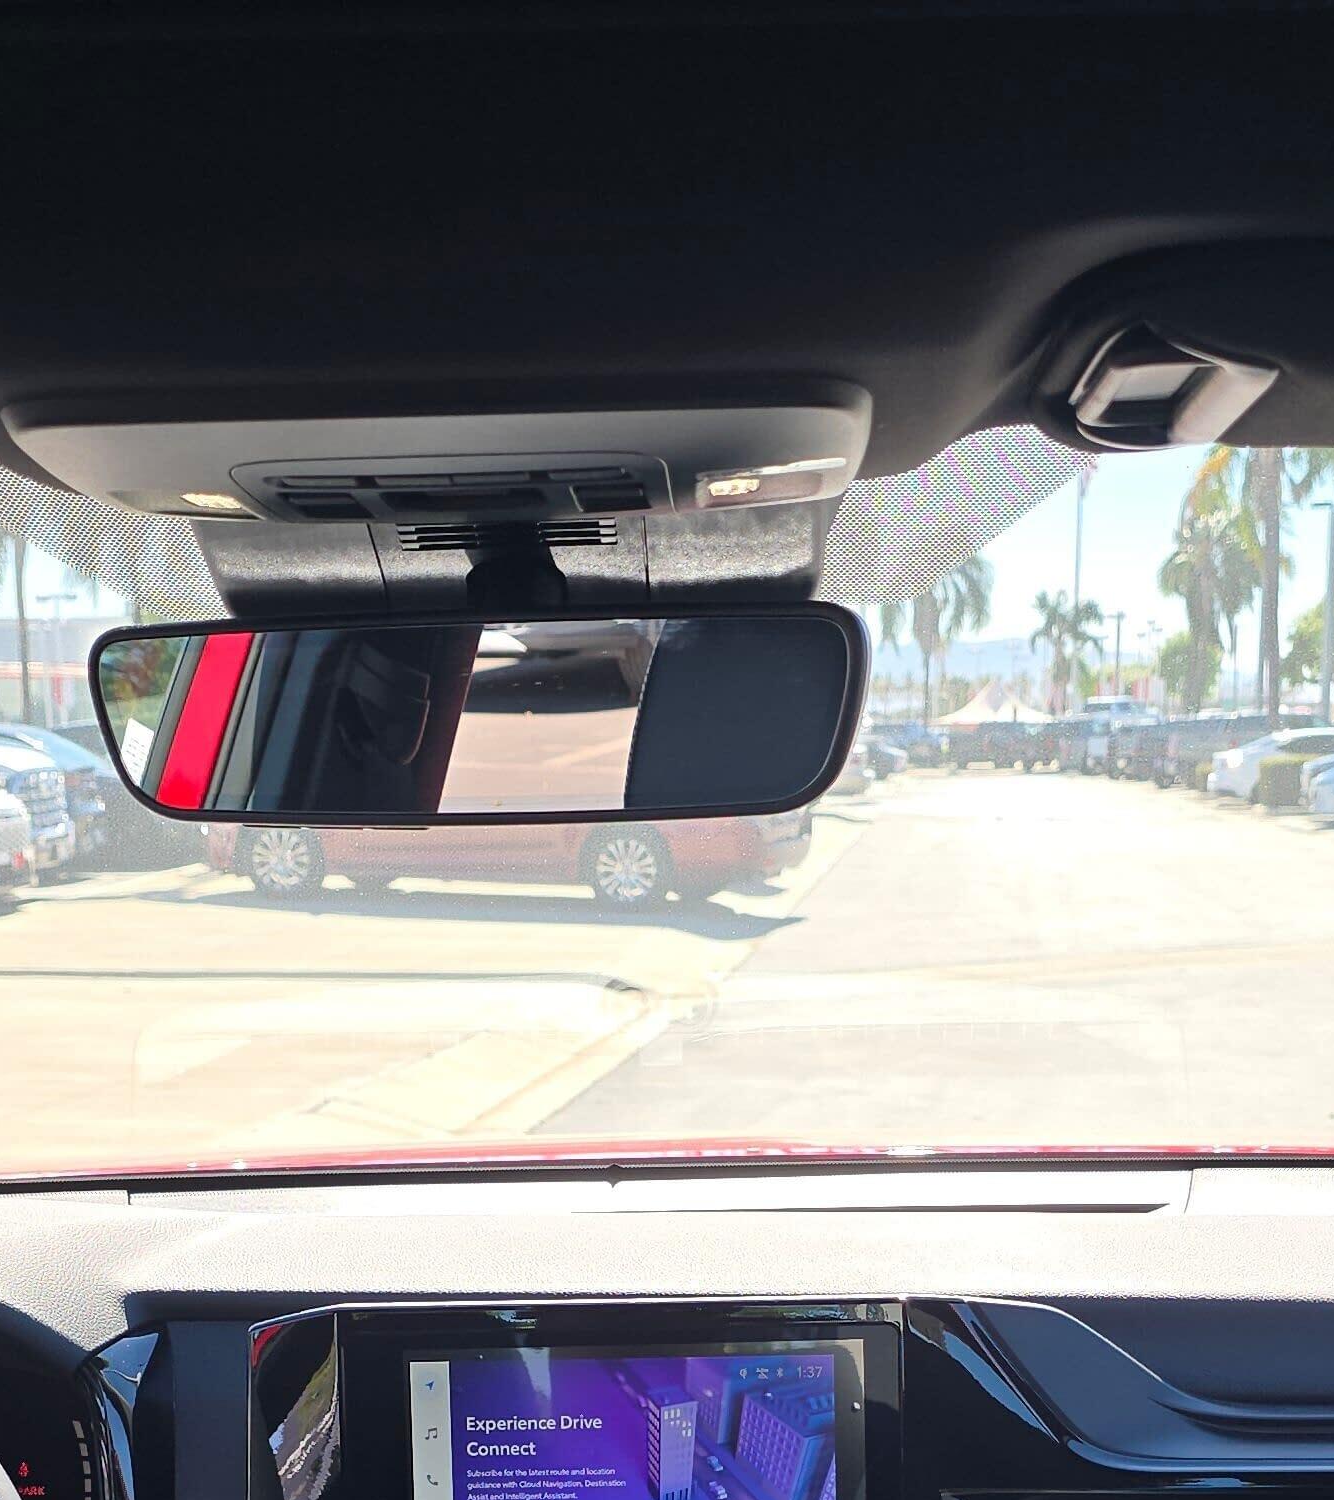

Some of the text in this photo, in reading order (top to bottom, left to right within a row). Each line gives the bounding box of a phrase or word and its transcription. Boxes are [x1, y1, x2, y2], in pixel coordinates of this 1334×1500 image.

[795, 1364, 824, 1380] 1:37
[466, 1414, 603, 1434] Experience Drive
[467, 1441, 537, 1457] Connect
[467, 1467, 616, 1478] Subscribe for the latest route and location
[467, 1481, 501, 1491] guidance
[502, 1480, 517, 1489] with
[518, 1480, 541, 1488] Cloud
[584, 1479, 627, 1487] Destination
[467, 1493, 489, 1500] Assist
